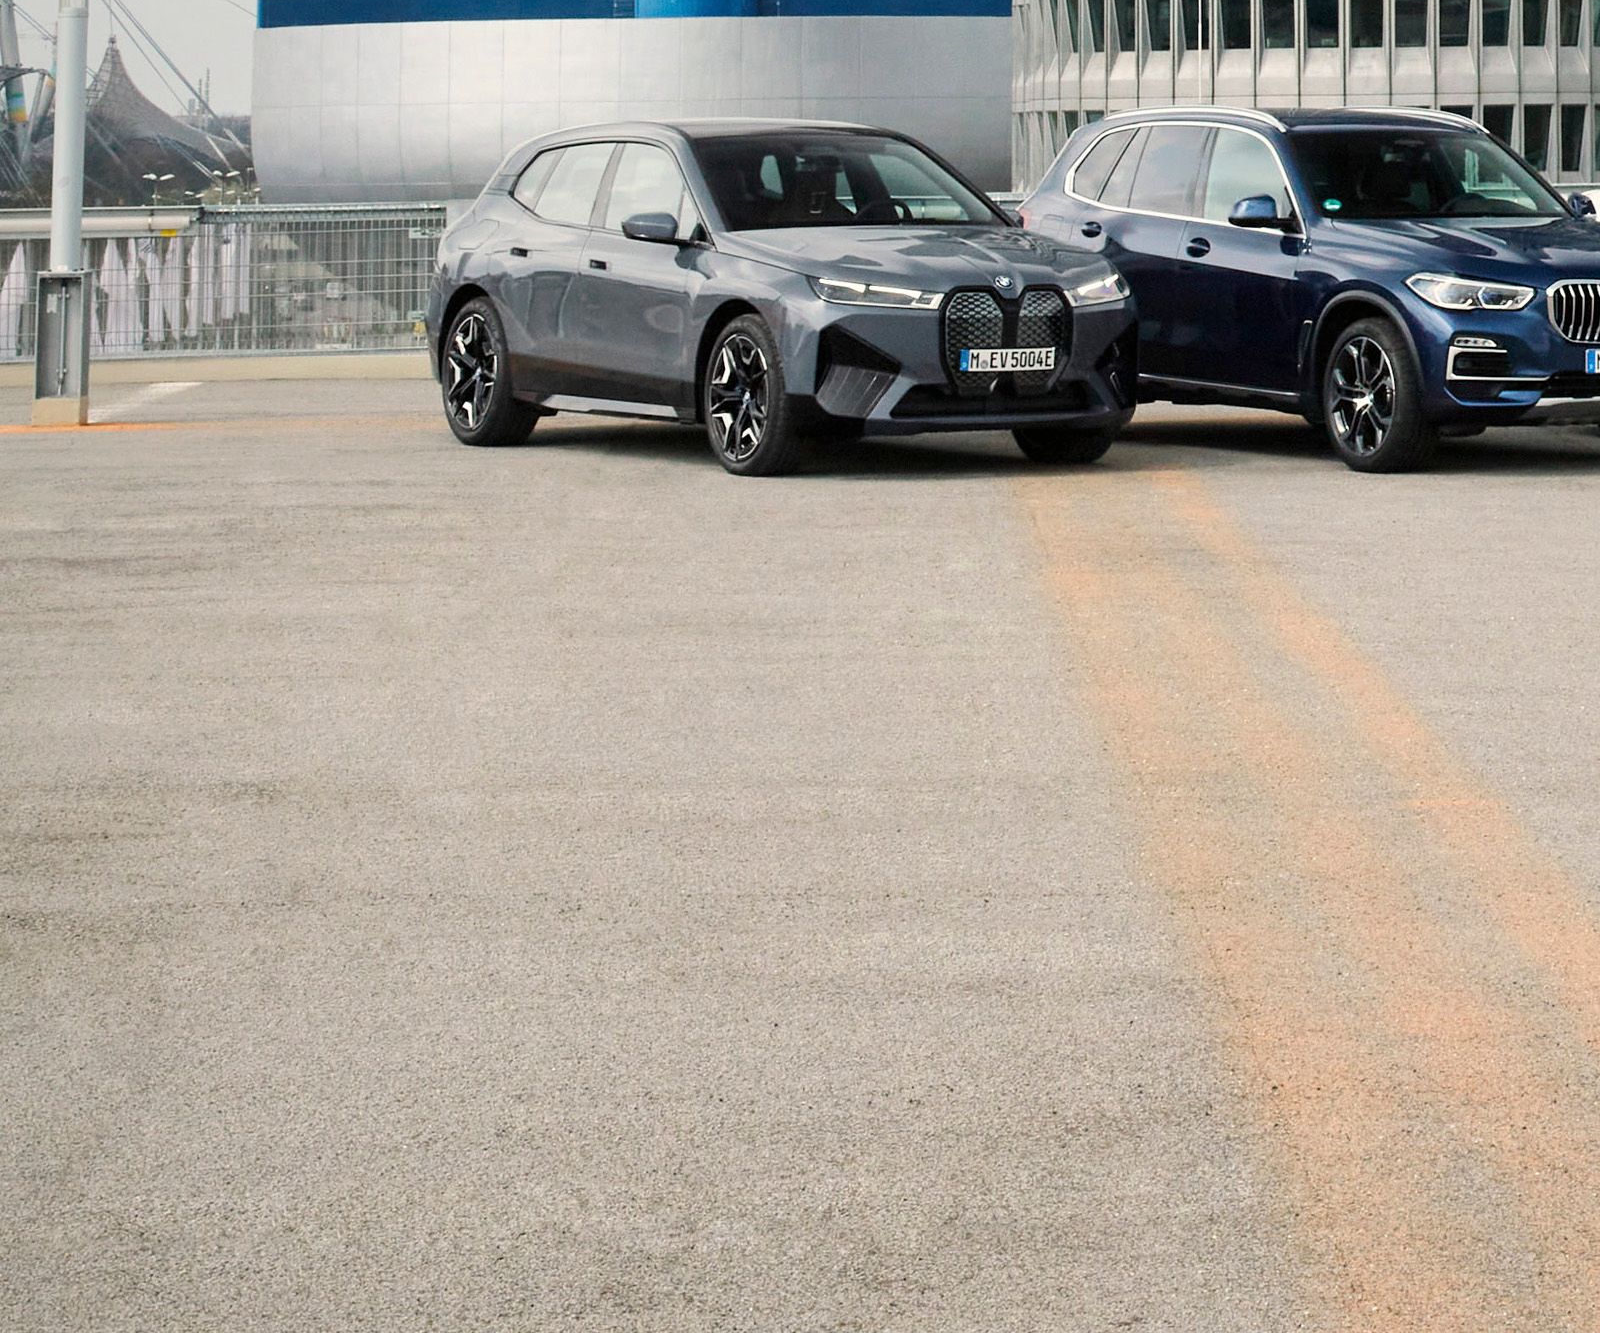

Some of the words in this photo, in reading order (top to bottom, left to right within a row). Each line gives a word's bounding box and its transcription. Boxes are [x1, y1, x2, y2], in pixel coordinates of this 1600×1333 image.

[970, 352, 980, 369] M
[990, 351, 1009, 369] EV
[1011, 349, 1053, 368] 5004E
